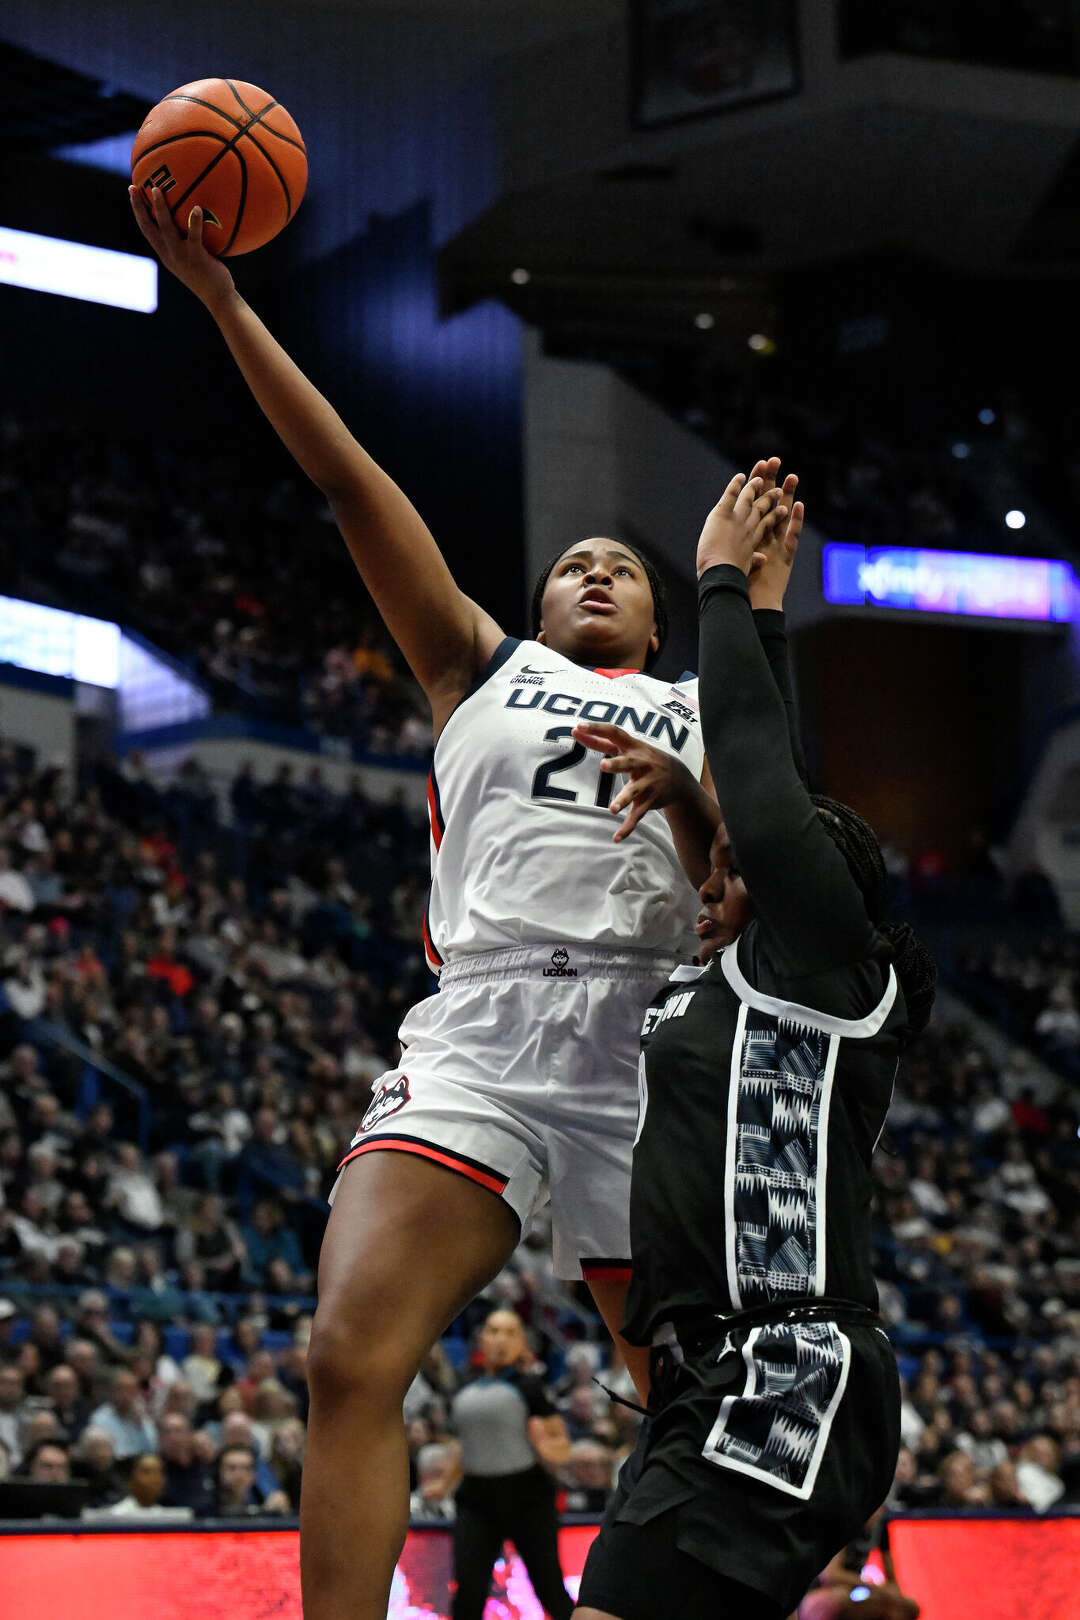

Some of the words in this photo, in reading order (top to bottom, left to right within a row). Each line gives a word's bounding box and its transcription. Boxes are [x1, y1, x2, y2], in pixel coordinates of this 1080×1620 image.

[510, 678, 545, 686] CHANGE
[504, 688, 690, 753] UCONN
[542, 967, 578, 977] UCONN
